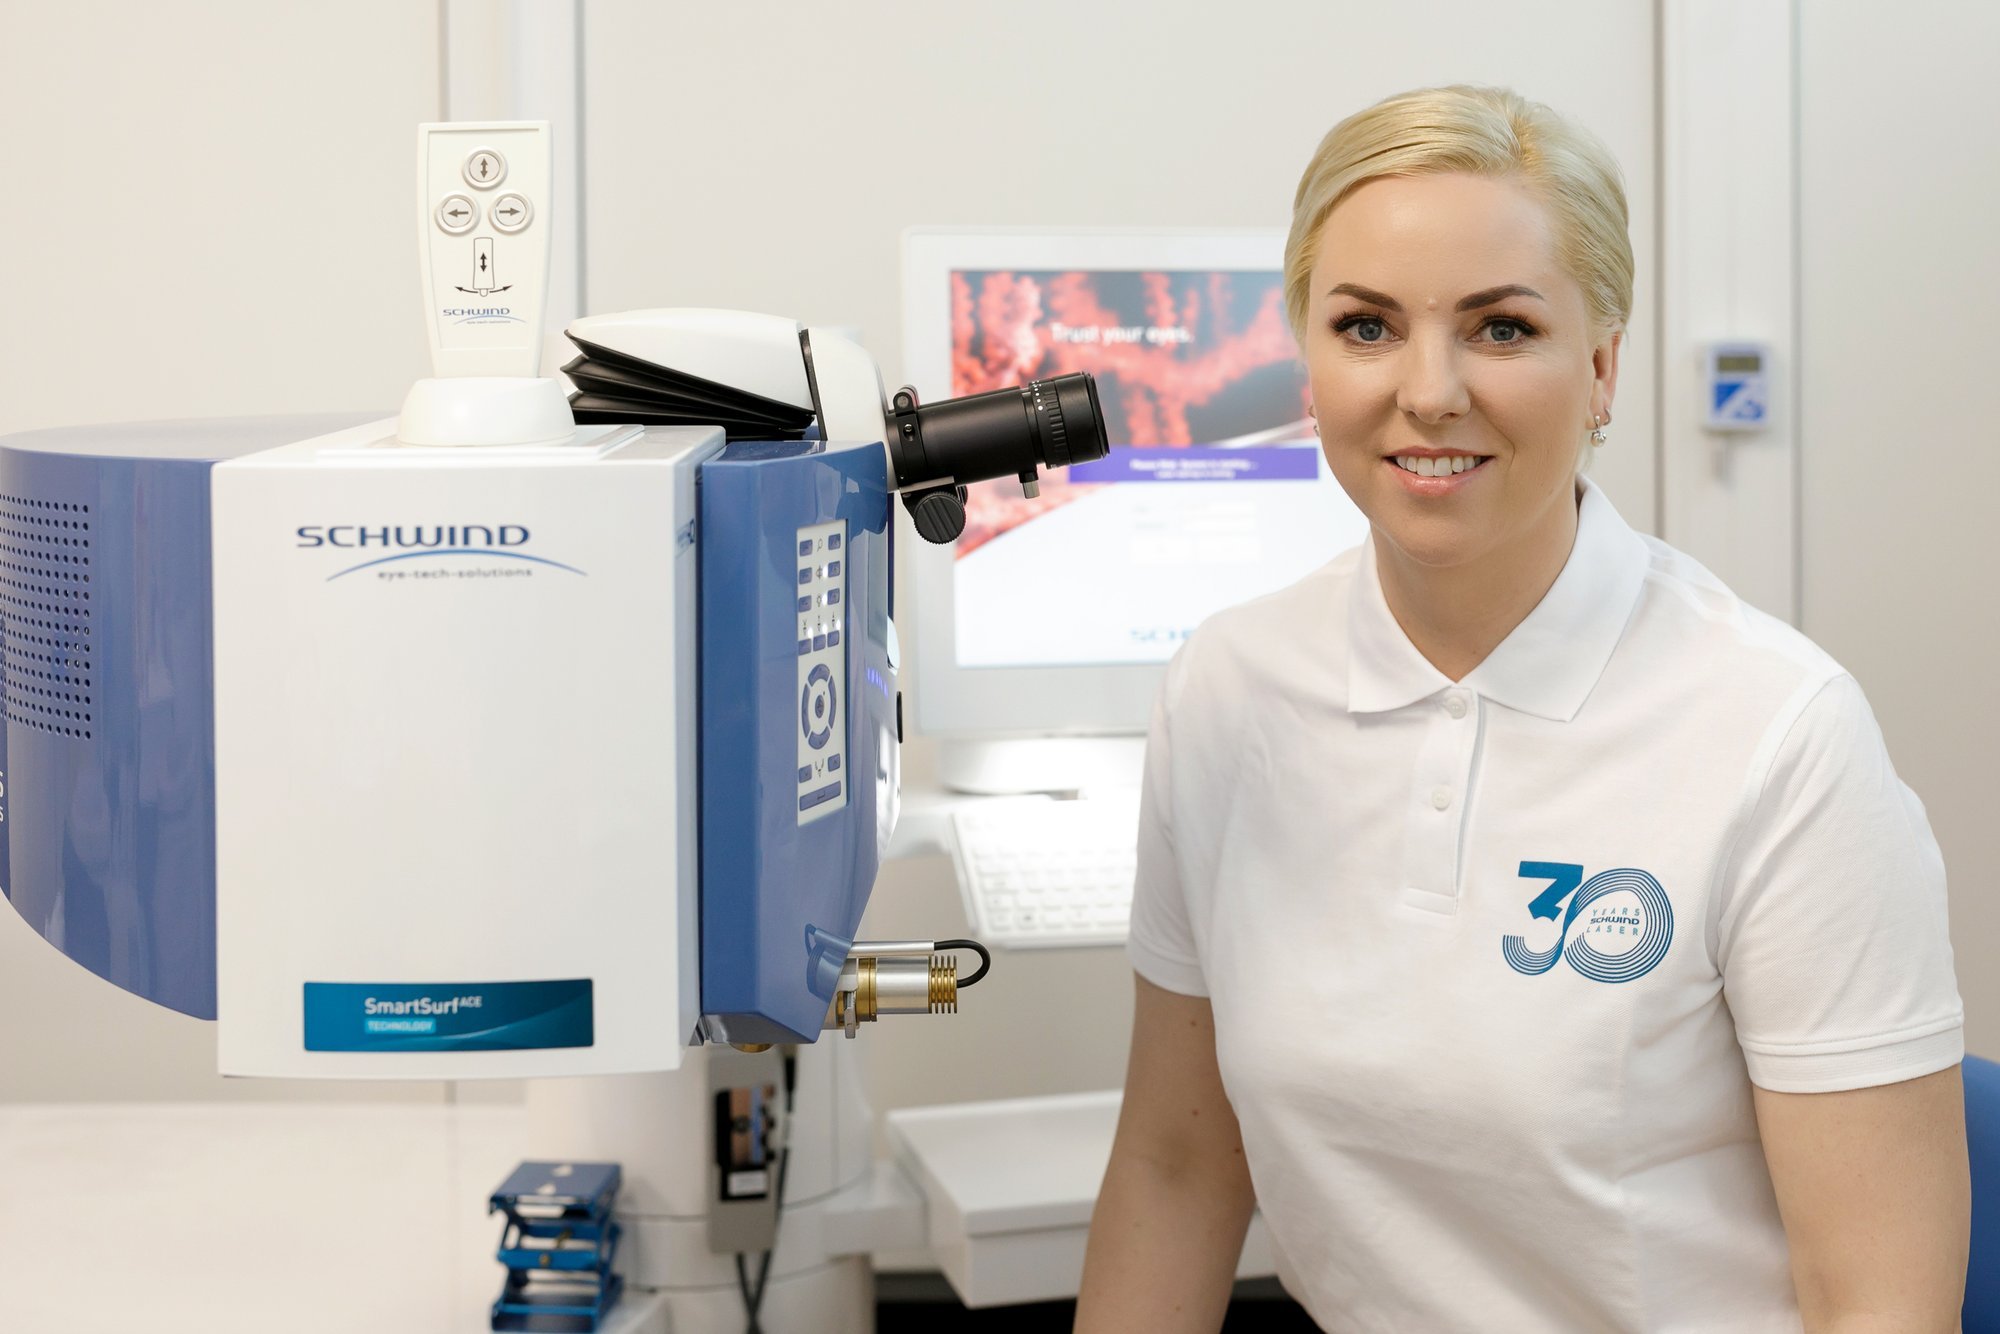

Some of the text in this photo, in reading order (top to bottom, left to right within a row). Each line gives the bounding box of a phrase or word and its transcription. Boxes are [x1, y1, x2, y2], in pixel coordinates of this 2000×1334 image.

[443, 307, 511, 316] SCHWIND
[1051, 323, 1099, 343] Trust
[1103, 326, 1143, 346] your
[296, 525, 531, 548] SCHWIND
[377, 567, 533, 582] eye-tech-solutions
[1592, 907, 1640, 917] YEARS
[1590, 916, 1640, 925] SCHWIND
[1586, 925, 1639, 936] LASER
[367, 1020, 434, 1032] TECHNOLOGY
